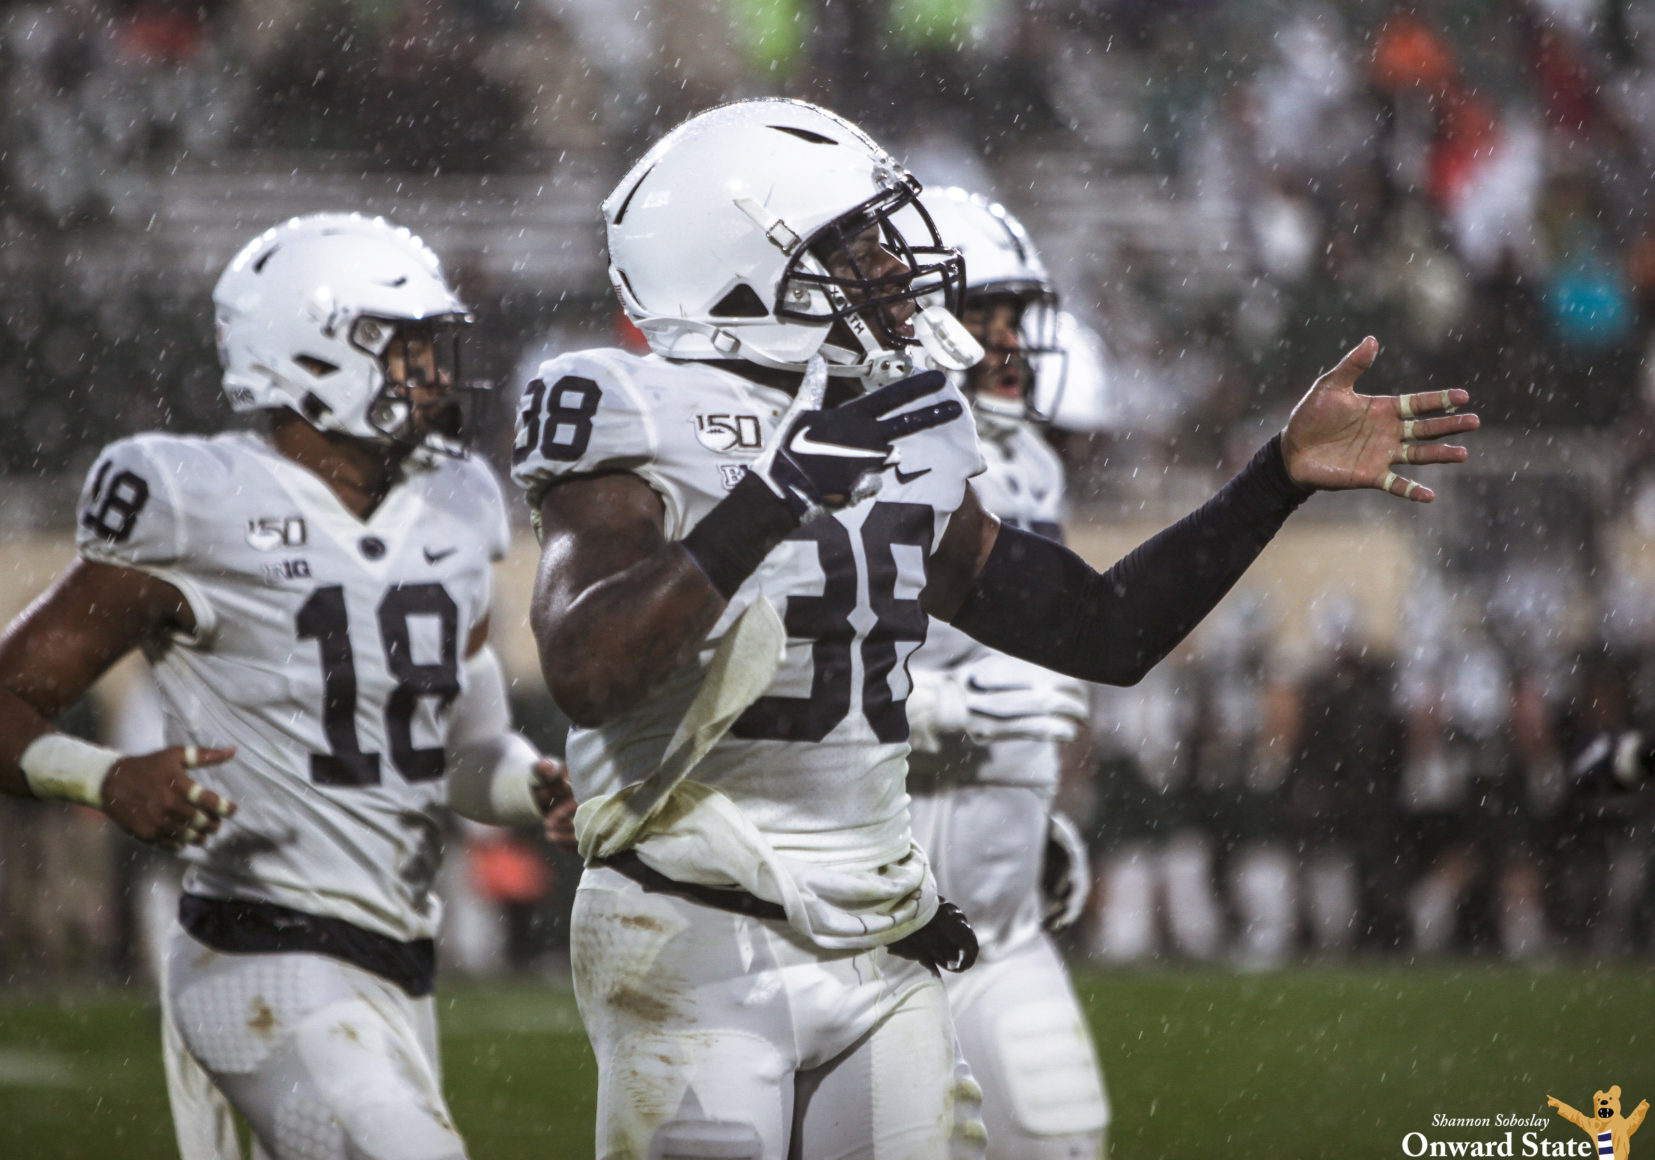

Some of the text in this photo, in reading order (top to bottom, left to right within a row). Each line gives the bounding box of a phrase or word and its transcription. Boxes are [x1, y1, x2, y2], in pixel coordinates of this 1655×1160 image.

[512, 375, 602, 467] 38
[294, 583, 460, 788] 18
[728, 500, 935, 744] 38
